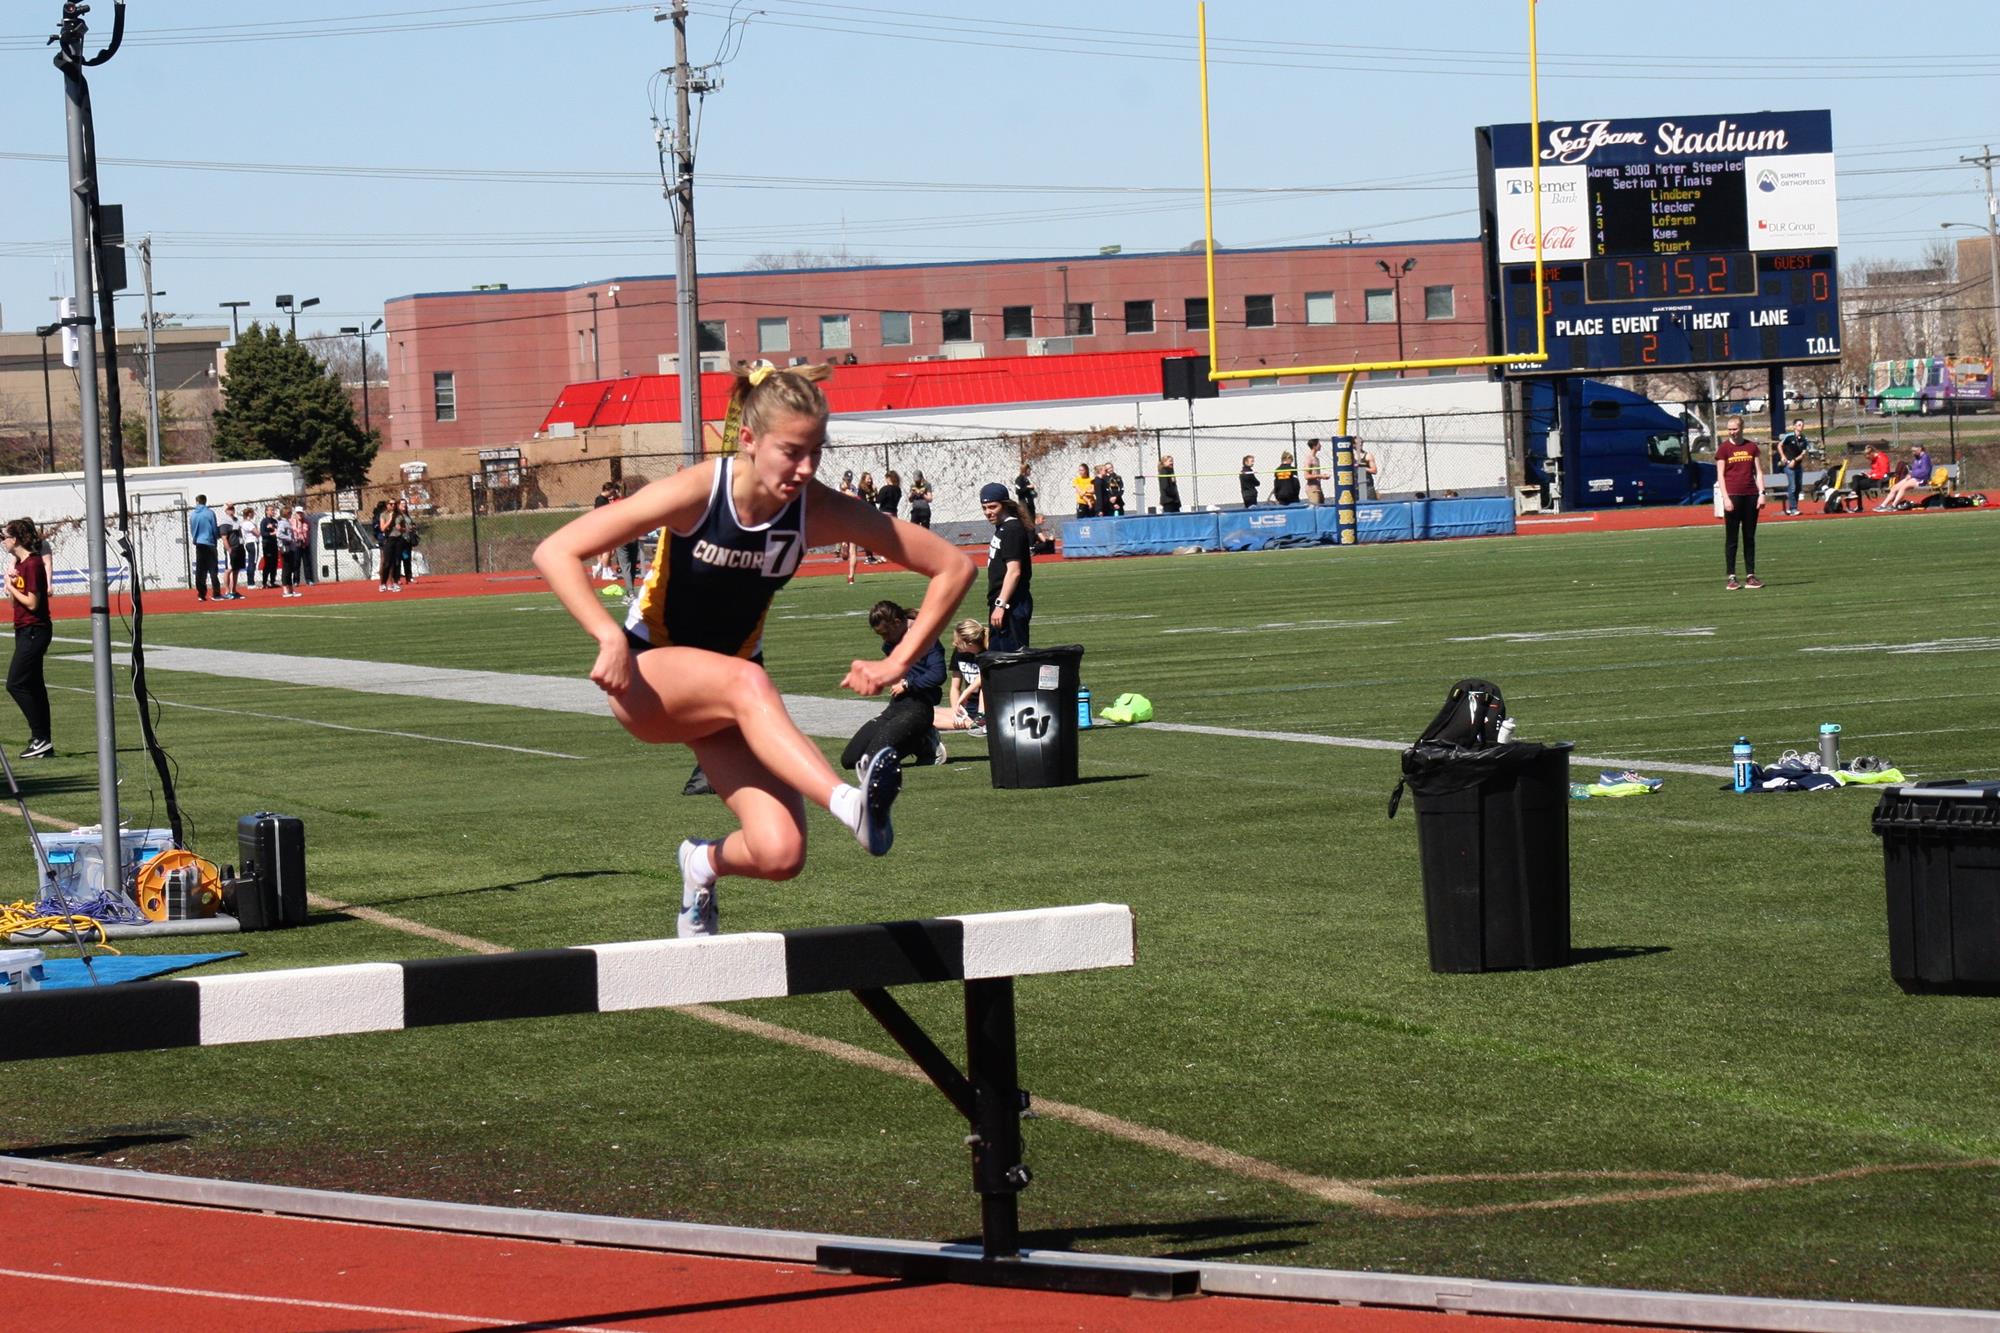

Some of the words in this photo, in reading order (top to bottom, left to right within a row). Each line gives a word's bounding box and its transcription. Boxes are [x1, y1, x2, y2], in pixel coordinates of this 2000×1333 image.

[1655, 120, 1788, 156] Stadium
[1587, 167, 1619, 178] Women
[1624, 164, 1651, 176] 3000
[1655, 163, 1687, 175] Meter
[1692, 161, 1744, 174] Steeplec
[1523, 179, 1577, 194] Bemer
[1613, 177, 1657, 189] Section
[1663, 176, 1668, 188] 1
[1674, 175, 1713, 187] Finals
[1780, 179, 1826, 187] ORTHOPEDICS
[1551, 193, 1578, 205] Bank
[1595, 192, 1601, 203] 1
[1595, 205, 1603, 216] 2
[1651, 202, 1696, 214] Klecker
[1596, 218, 1603, 229] 3
[1768, 223, 1786, 232] DLR
[1788, 223, 1816, 232] Group
[1597, 231, 1604, 242] 4
[1652, 228, 1678, 240] Kyes
[1598, 244, 1605, 255] 5
[1653, 241, 1692, 253] Stuart
[1774, 255, 1813, 270] GUEST
[1530, 268, 1561, 281] HME
[1616, 257, 1727, 294] 7:15.2
[1811, 272, 1828, 301] 0
[1555, 318, 1604, 337] PLACE
[1611, 316, 1660, 334] EVENT
[1692, 312, 1731, 330] HEAT
[1750, 309, 1789, 327] LANE
[1642, 334, 1657, 363] 2
[1723, 332, 1729, 357] 1
[1806, 337, 1841, 355] T.O.L.
[1337, 451, 1356, 545] BEARS
[1249, 514, 1287, 525] UCS
[1357, 509, 1383, 520] CS
[770, 533, 797, 575] 7
